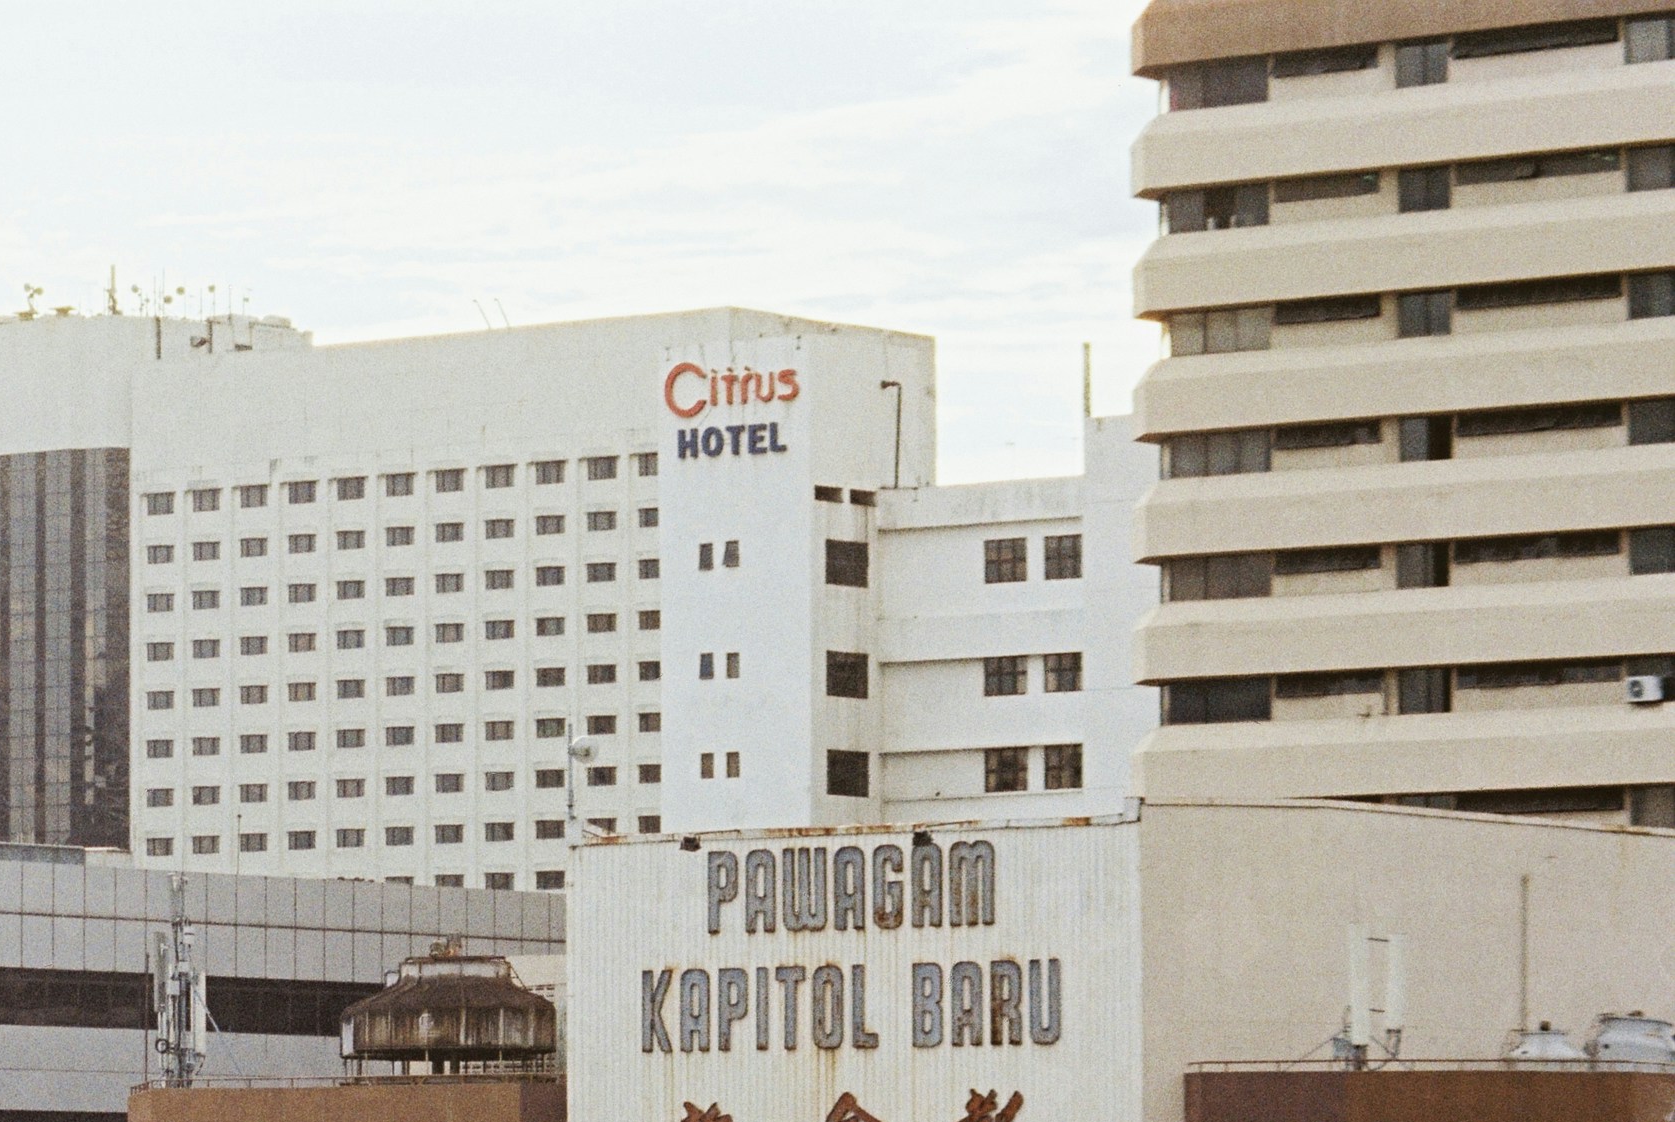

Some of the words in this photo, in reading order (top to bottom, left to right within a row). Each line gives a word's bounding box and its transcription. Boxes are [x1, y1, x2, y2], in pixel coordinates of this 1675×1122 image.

[665, 364, 800, 418] Citrus
[678, 422, 788, 459] HOTEL
[707, 840, 996, 934] PAWAGAM
[641, 966, 879, 1053] KAPITOL
[911, 958, 1062, 1048] BARU
